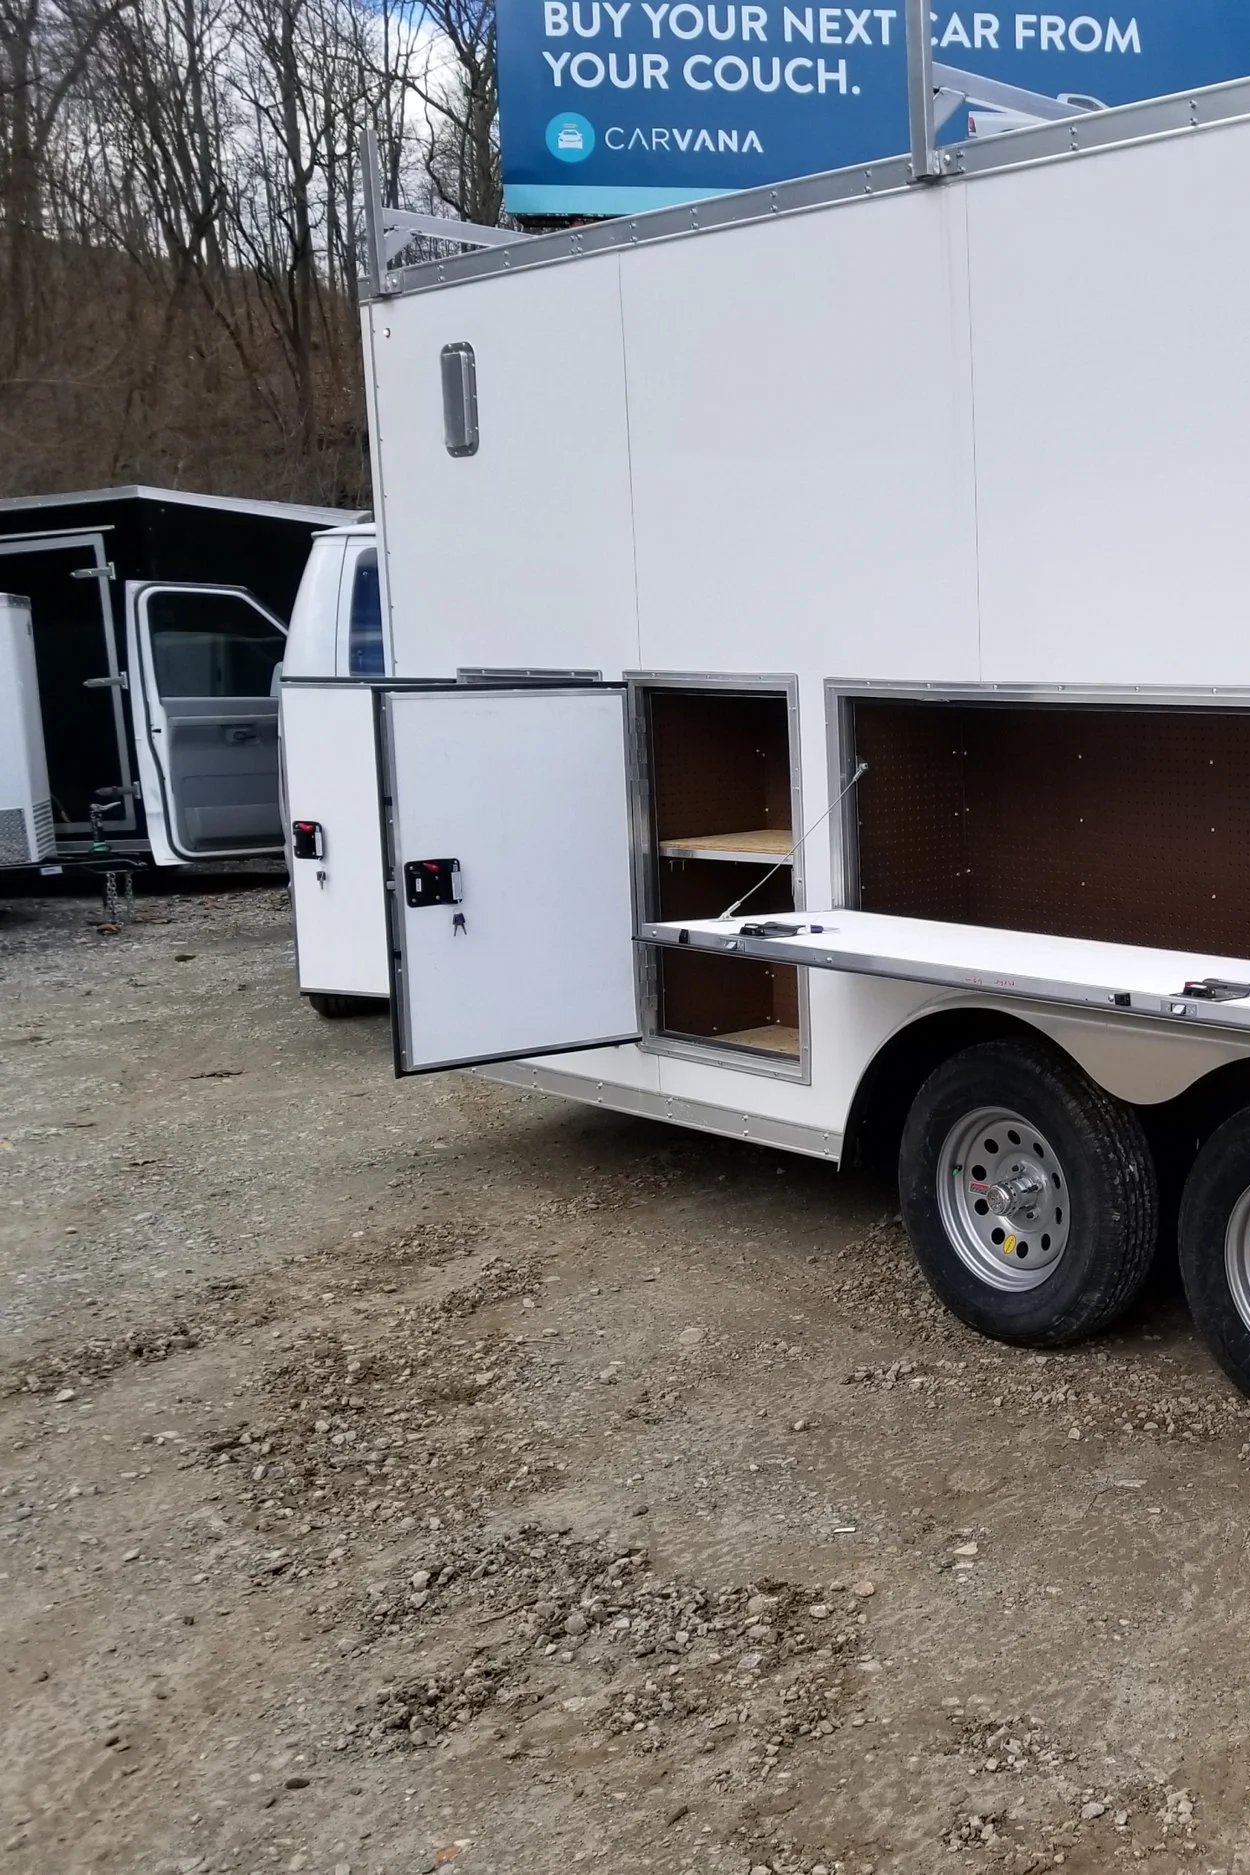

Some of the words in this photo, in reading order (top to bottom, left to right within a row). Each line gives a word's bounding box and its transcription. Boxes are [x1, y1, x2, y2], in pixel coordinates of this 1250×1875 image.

[543, 1, 631, 38] BUY
[641, 3, 768, 42] YOUR
[783, 6, 898, 45] NEXT
[1014, 14, 1142, 54] FROM
[542, 51, 670, 90] YOUR
[682, 54, 861, 95] COUCH.
[604, 126, 764, 153] CARVANA
